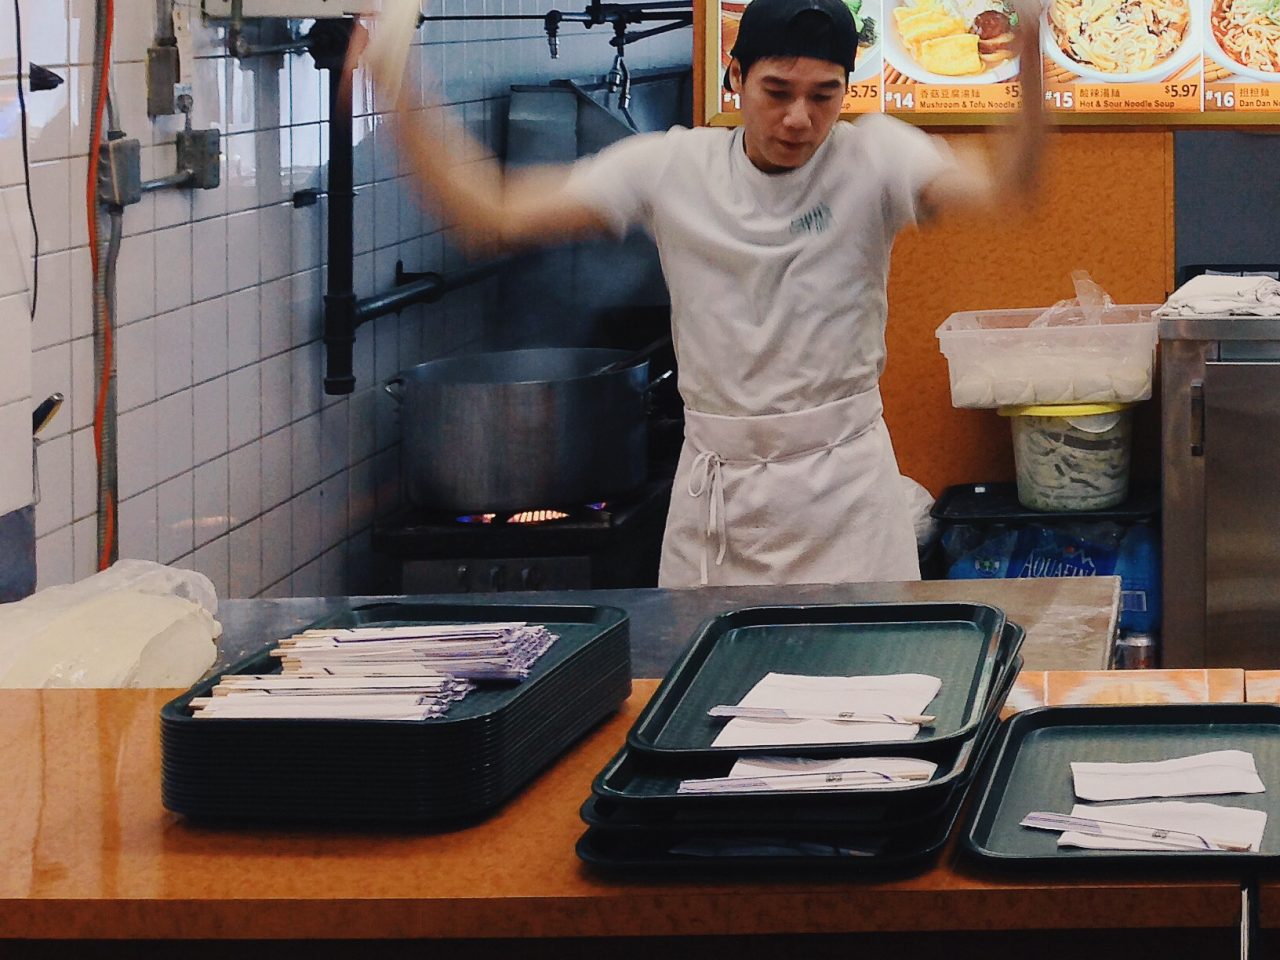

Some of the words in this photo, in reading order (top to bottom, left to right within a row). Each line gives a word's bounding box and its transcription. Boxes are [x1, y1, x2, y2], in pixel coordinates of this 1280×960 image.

[1165, 85, 1197, 97] $5.97
[1206, 91, 1234, 107] #16
[885, 92, 913, 108] #14
[1044, 91, 1073, 108] #15
[1155, 100, 1175, 108] Soup
